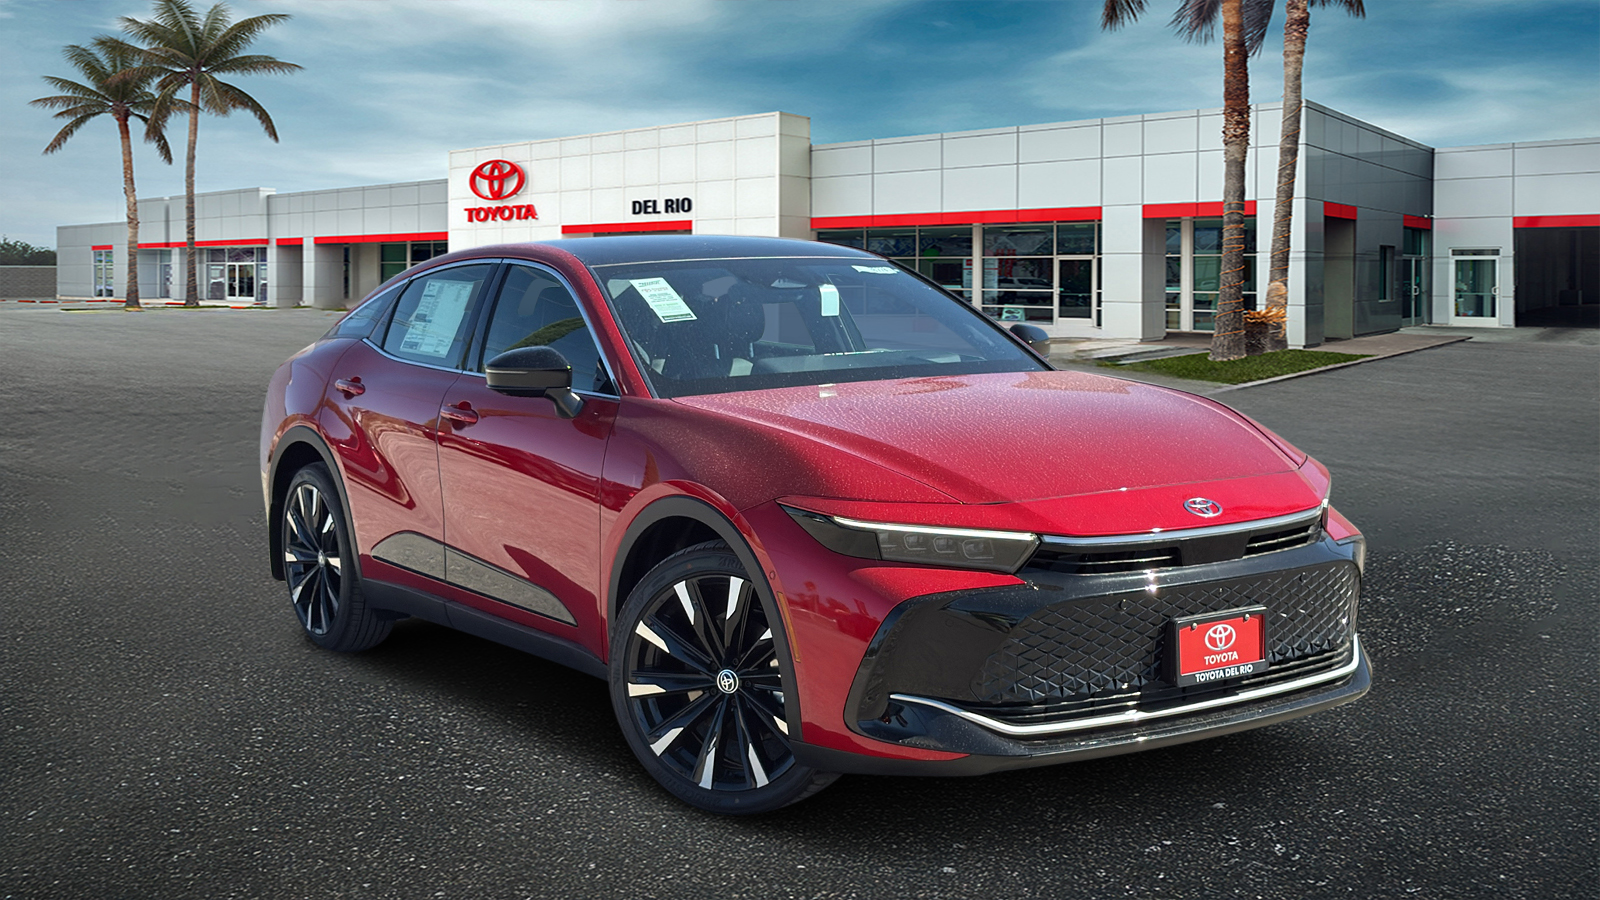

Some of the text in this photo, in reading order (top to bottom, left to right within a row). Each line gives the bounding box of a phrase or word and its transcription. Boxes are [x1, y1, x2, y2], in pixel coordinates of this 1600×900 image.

[464, 204, 538, 223] TOYOTA
[632, 197, 692, 215] DEL RIO
[1204, 651, 1238, 665] TOYOTA
[1195, 664, 1253, 682] TOYOTA DEL RIO
